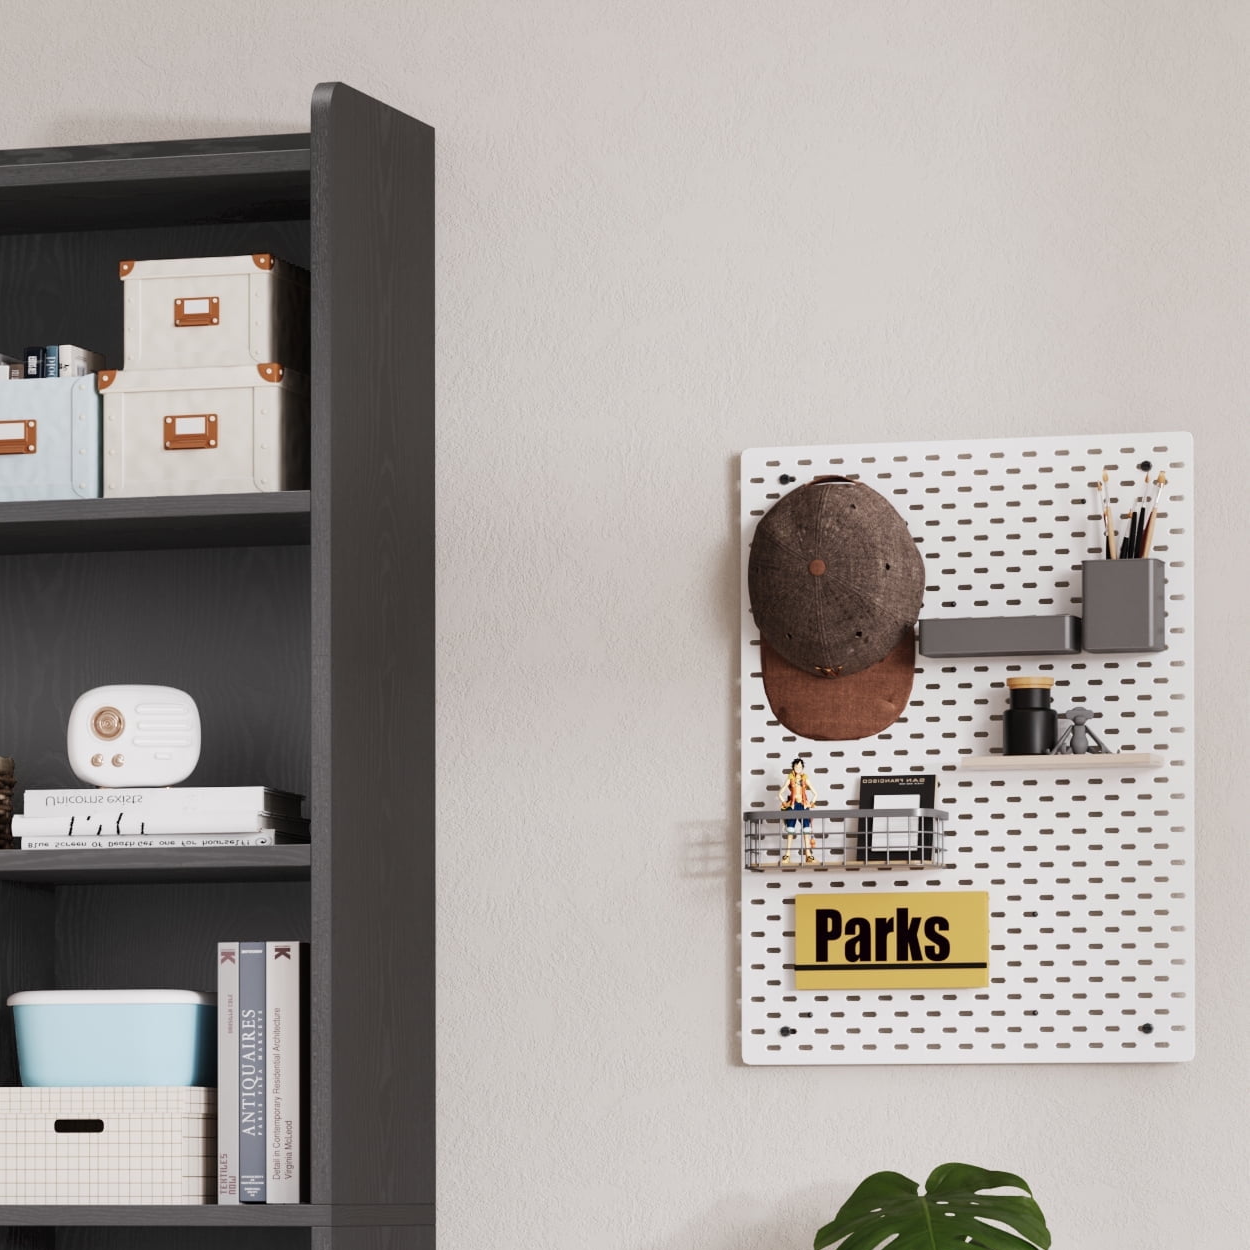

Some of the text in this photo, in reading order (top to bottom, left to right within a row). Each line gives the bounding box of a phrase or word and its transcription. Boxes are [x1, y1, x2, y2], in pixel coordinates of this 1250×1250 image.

[815, 907, 951, 962] Parks
[272, 1007, 281, 1051] Architecture
[241, 1009, 259, 1137] ANTIQUAIRES
[272, 1053, 281, 1094] Residential
[272, 1096, 282, 1148] Contemporary
[220, 1153, 228, 1194] TEXTILES
[272, 1158, 281, 1180] Detail
[284, 1120, 294, 1180] Virginia McLeod
